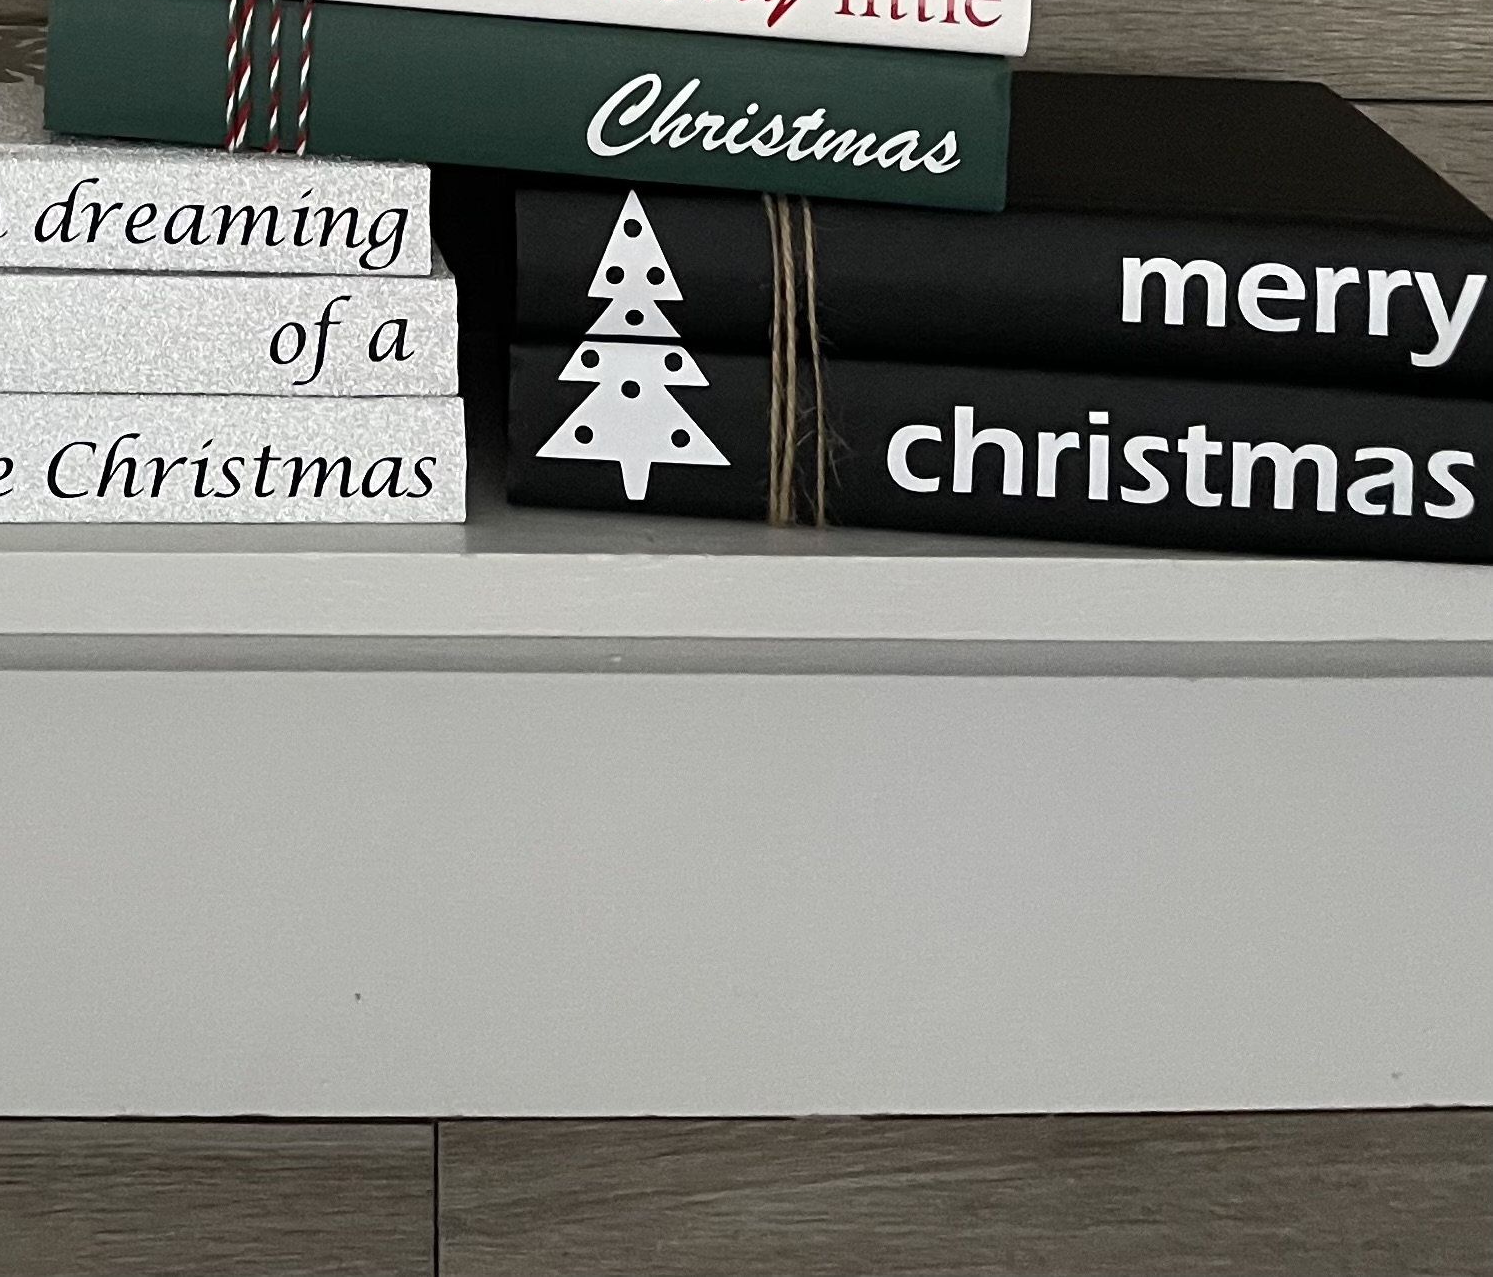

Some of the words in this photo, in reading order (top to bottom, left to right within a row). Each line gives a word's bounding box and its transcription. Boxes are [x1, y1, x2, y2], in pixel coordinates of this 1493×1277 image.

[586, 72, 962, 175] Christmas
[33, 177, 409, 271] dreaming
[268, 295, 353, 386] of
[367, 316, 415, 363] a
[1121, 256, 1488, 368] merry
[46, 432, 438, 500] Christmas
[886, 405, 1477, 520] christmas
